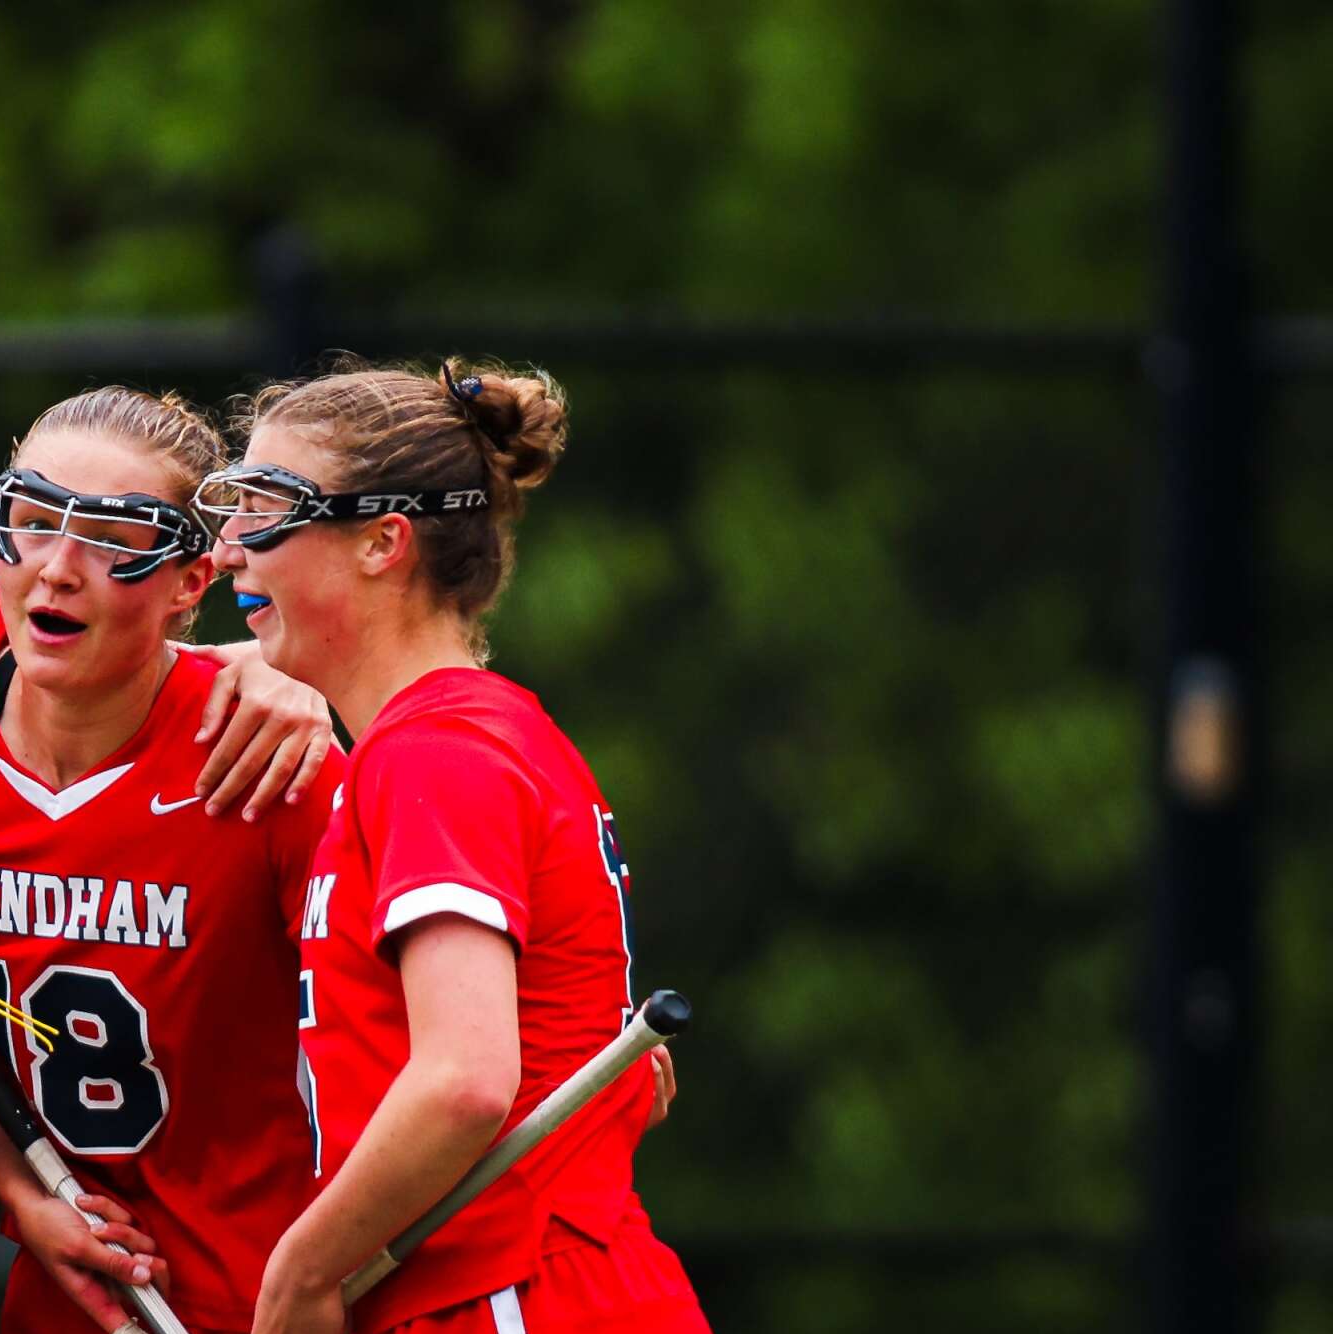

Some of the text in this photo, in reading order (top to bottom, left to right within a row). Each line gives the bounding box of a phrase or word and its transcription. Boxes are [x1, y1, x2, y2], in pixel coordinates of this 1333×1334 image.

[101, 497, 125, 507] STX
[357, 493, 423, 513] STX
[443, 489, 488, 508] STX
